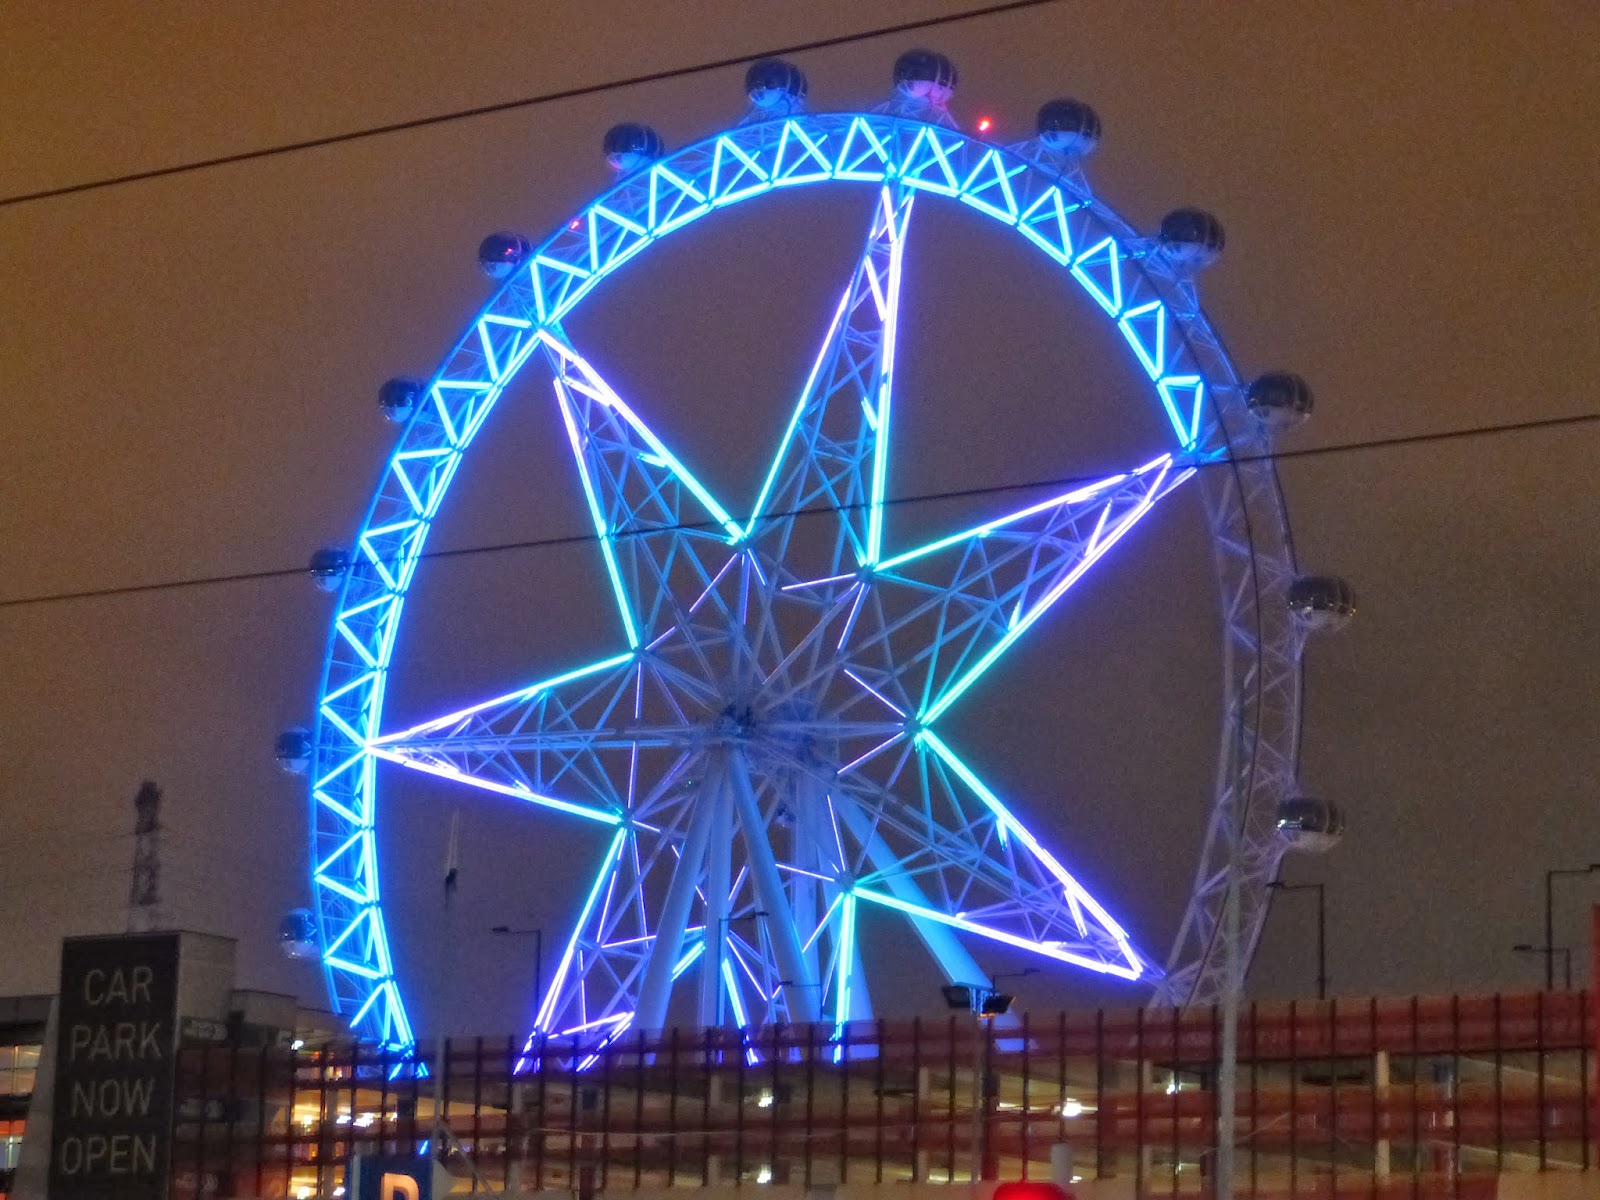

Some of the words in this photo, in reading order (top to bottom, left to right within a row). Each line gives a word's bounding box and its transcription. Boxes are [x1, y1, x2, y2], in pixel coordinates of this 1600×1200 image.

[84, 966, 152, 1006] CAR
[70, 1022, 161, 1060] PARK
[71, 1078, 153, 1117] NOW
[62, 1134, 156, 1175] OPEN
